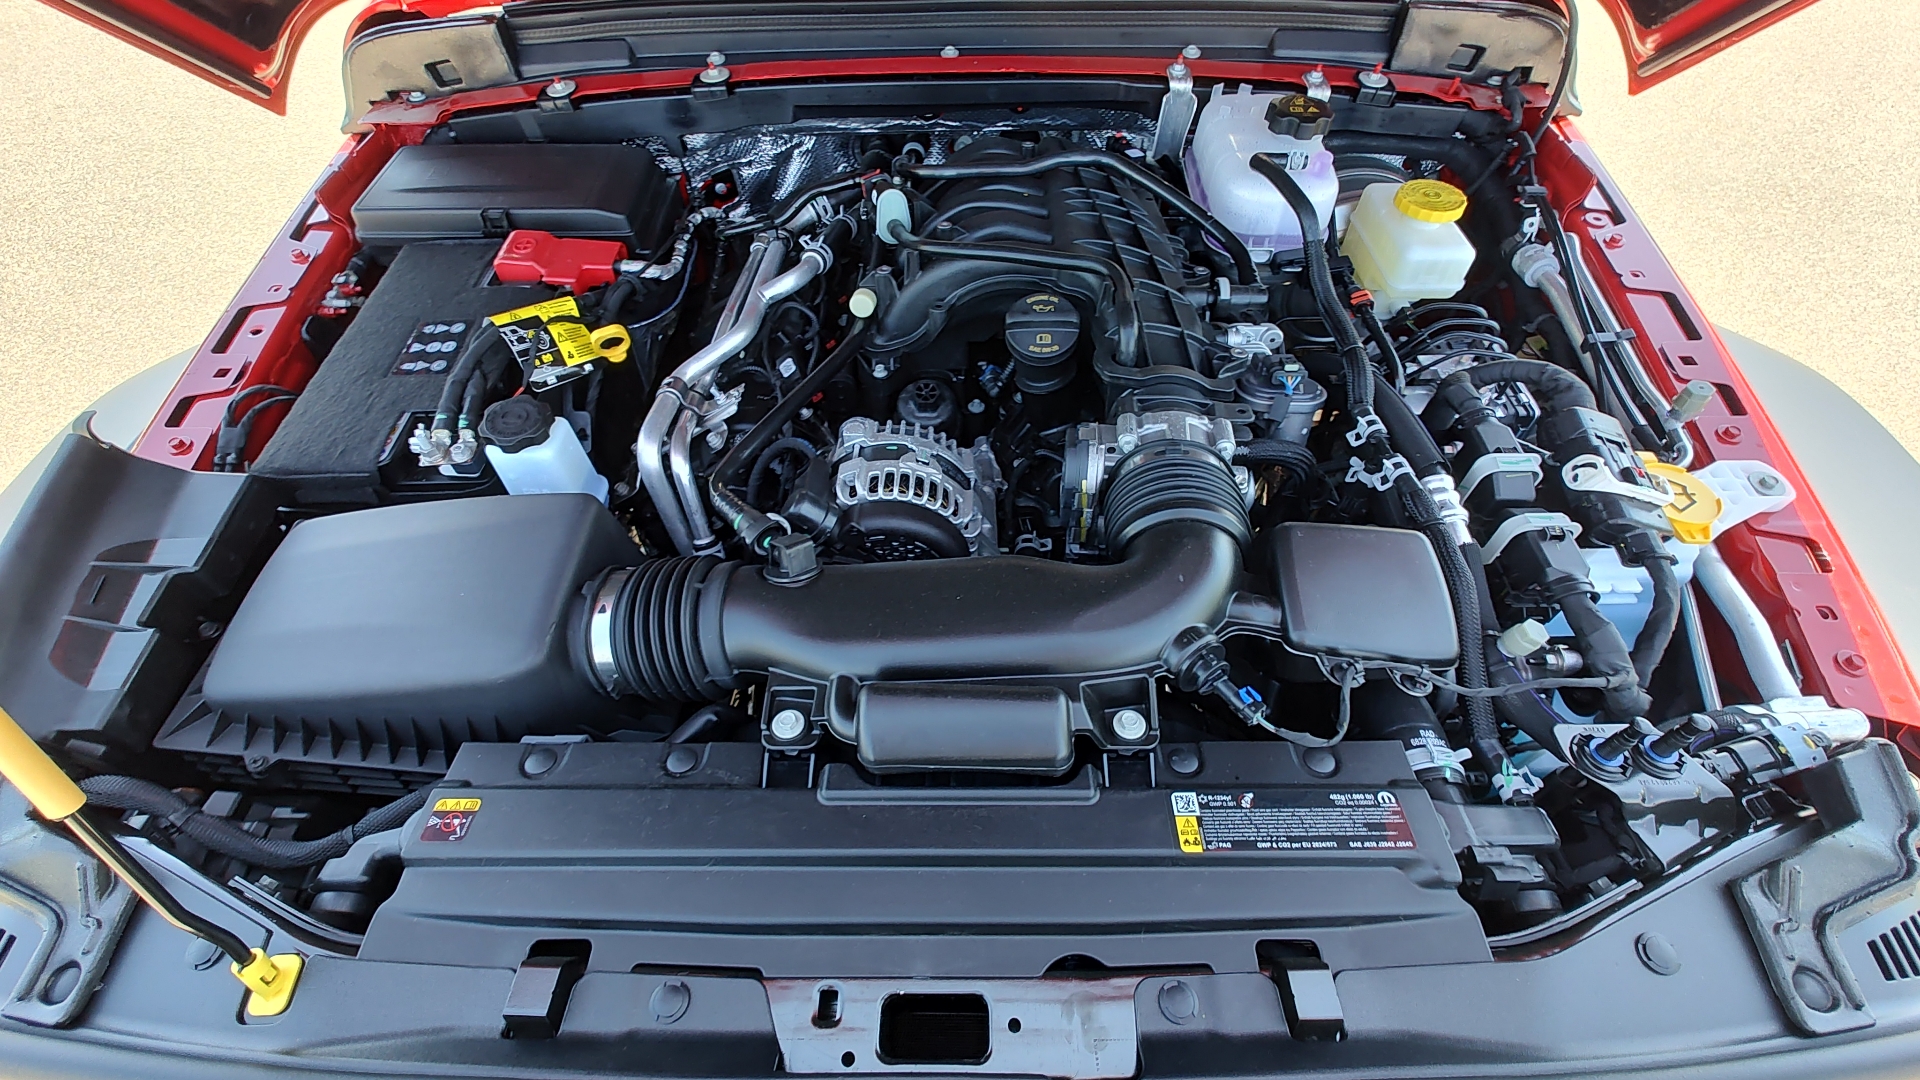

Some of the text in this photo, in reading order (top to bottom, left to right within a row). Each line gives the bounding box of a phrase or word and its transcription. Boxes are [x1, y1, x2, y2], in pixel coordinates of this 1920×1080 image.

[1026, 295, 1059, 304] ENGINE OIL
[1028, 345, 1042, 353] SAE
